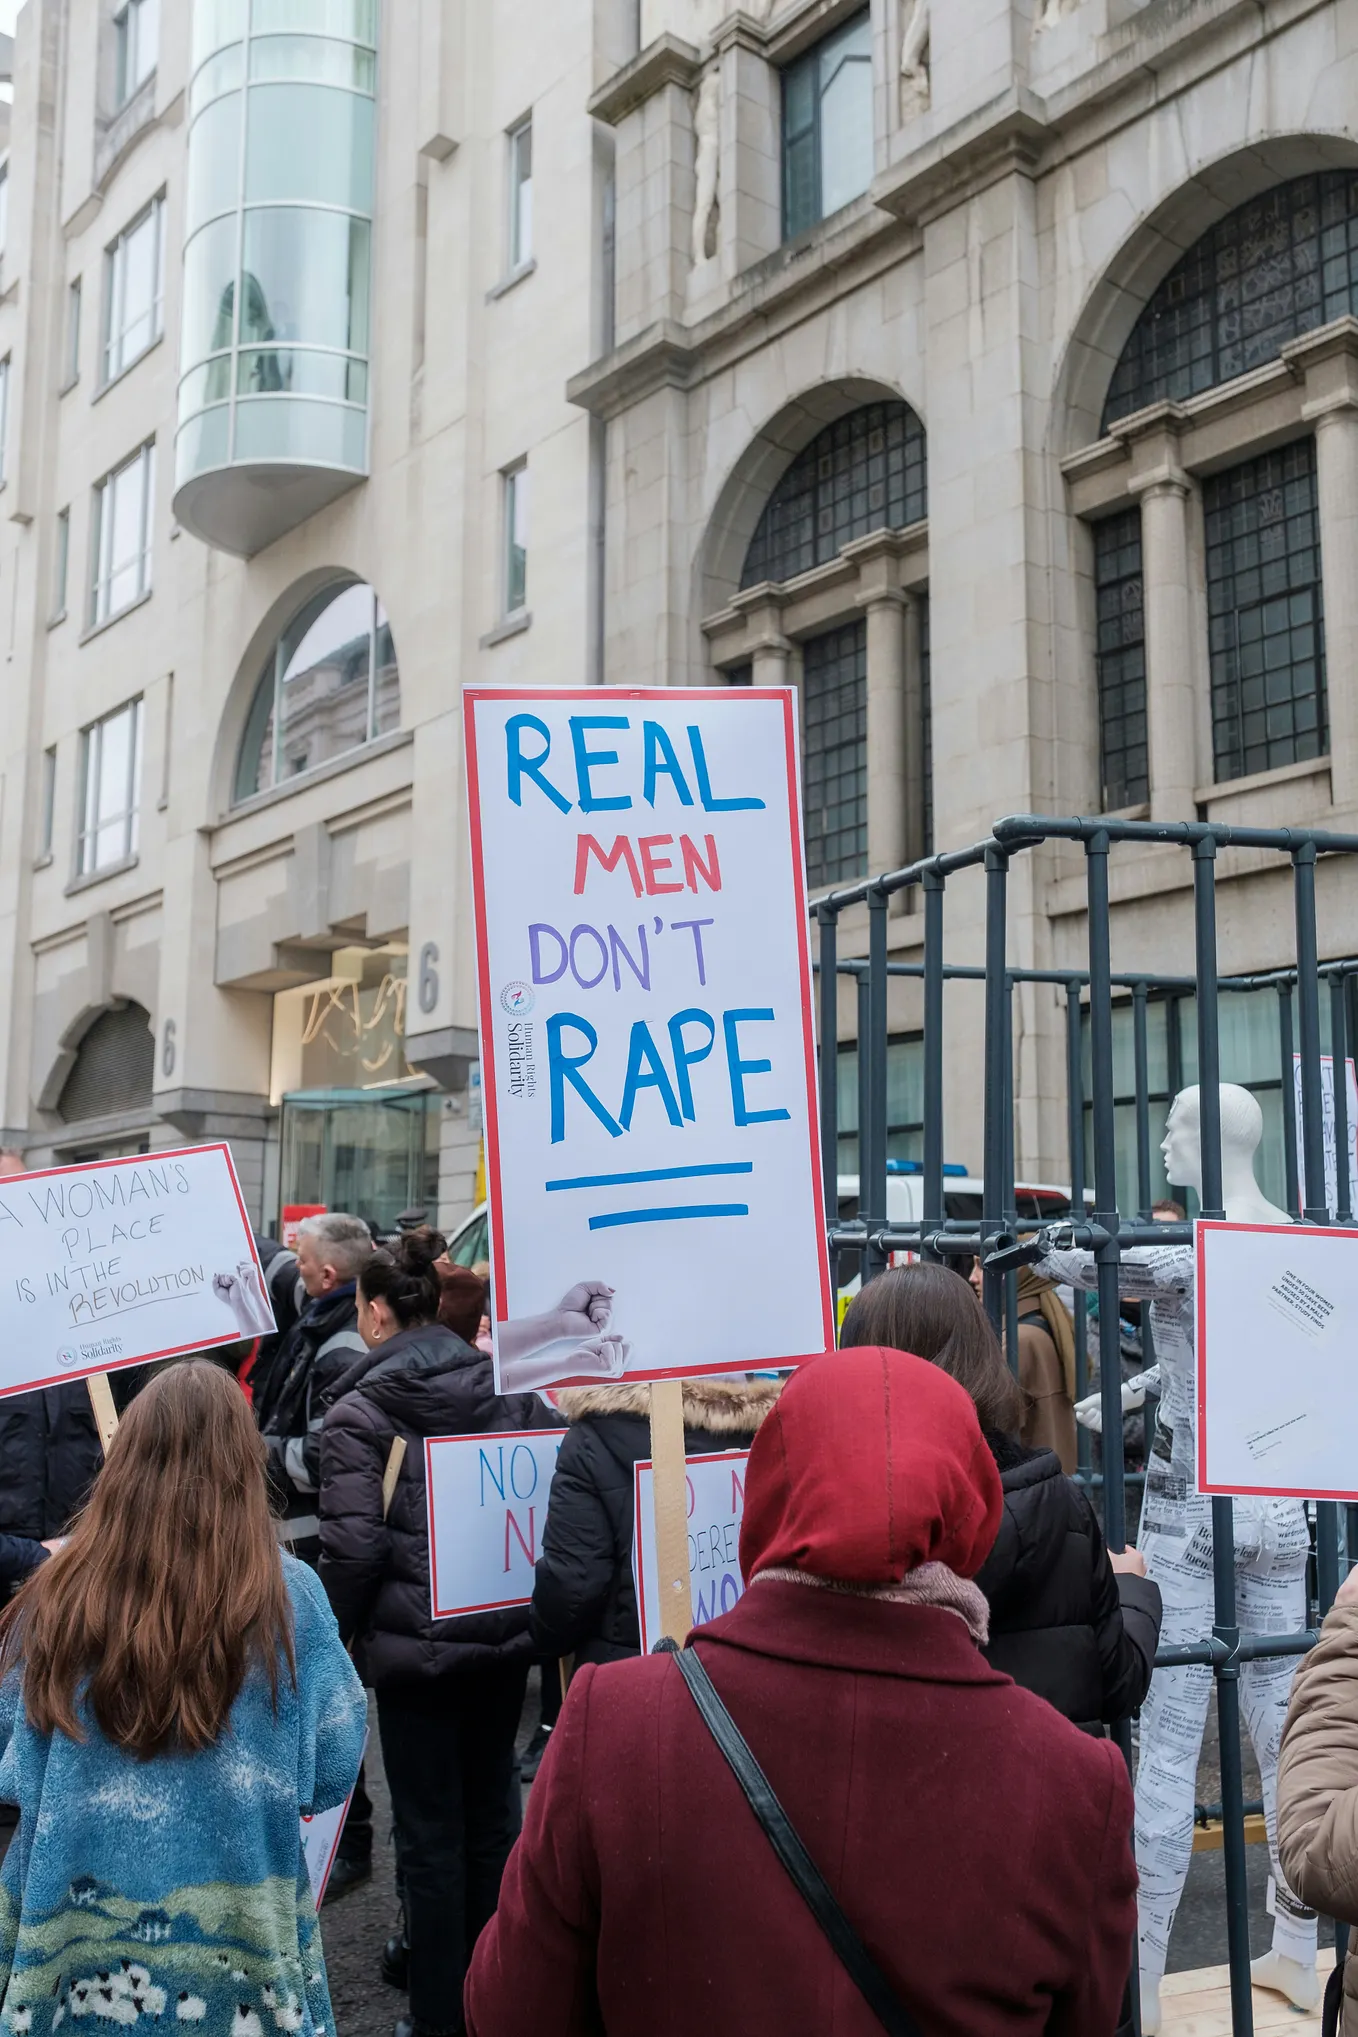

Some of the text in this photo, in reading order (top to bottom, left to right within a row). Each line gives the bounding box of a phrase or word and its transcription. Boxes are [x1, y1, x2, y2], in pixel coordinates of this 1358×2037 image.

[505, 713, 766, 814] REAL
[573, 833, 722, 898] MEN
[418, 942, 439, 1014] 6
[527, 916, 714, 992] DON'T
[162, 1019, 176, 1077] 6
[507, 1022, 526, 1098] Solidarity
[524, 1022, 537, 1098] Human Rights
[545, 1007, 791, 1145] RAPE
[28, 1163, 189, 1224] WOMAN'S
[61, 1213, 165, 1258] PLACE
[15, 1256, 122, 1303] IS IN THE
[68, 1265, 205, 1323] REVOLUTION
[1280, 1284, 1301, 1301] ABUSED
[1310, 1307, 1324, 1319] MALE
[1281, 1275, 1299, 1290] UNDER
[1304, 1294, 1318, 1306] HAVE
[1317, 1304, 1330, 1316] BEEN
[1285, 1270, 1297, 1281] ONE
[1302, 1282, 1316, 1295] FOUR
[1315, 1293, 1335, 1310] WOMEN
[1294, 1303, 1311, 1318] STUDY
[1310, 1315, 1325, 1330] FINDS
[81, 1344, 123, 1360] Solidarity
[479, 1444, 538, 1507] NO
